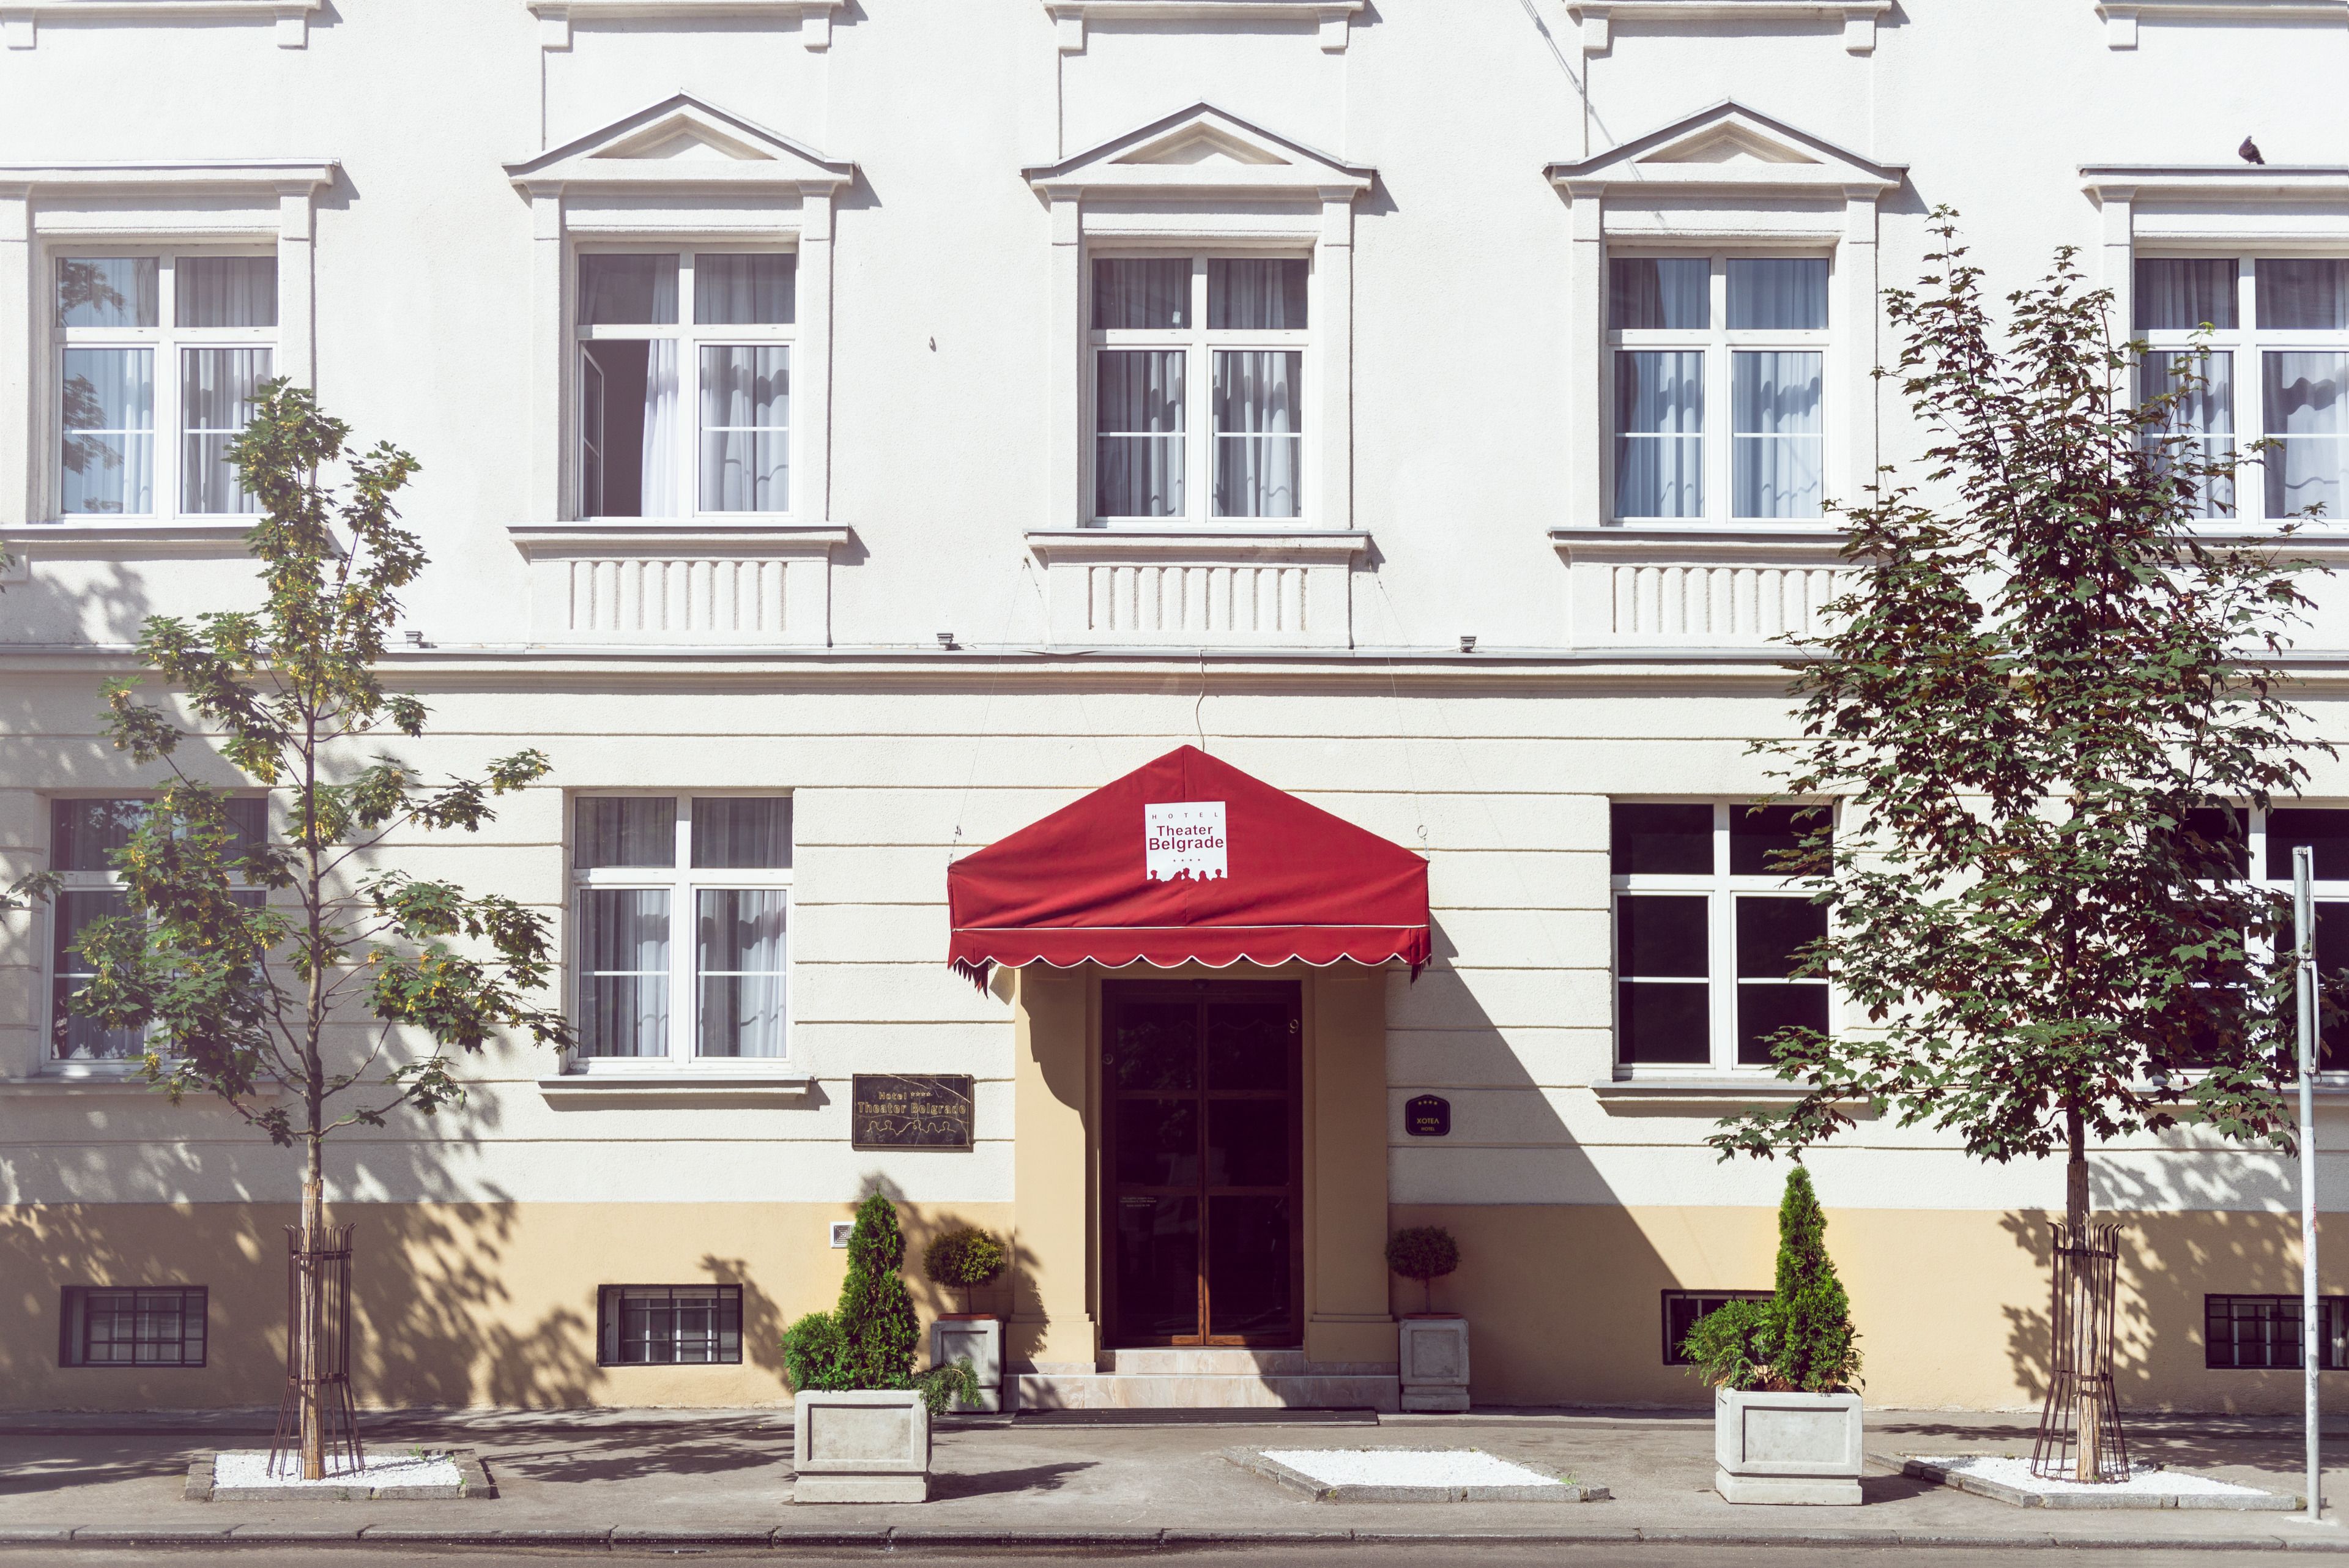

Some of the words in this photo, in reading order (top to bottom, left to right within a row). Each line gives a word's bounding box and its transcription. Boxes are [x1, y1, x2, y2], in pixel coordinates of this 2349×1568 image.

[1156, 825, 1213, 836] Theater
[1149, 836, 1224, 853] Belgrade
[878, 1091, 907, 1100] Hotel
[858, 1101, 907, 1113] Theater
[911, 1102, 967, 1115] Belgrade
